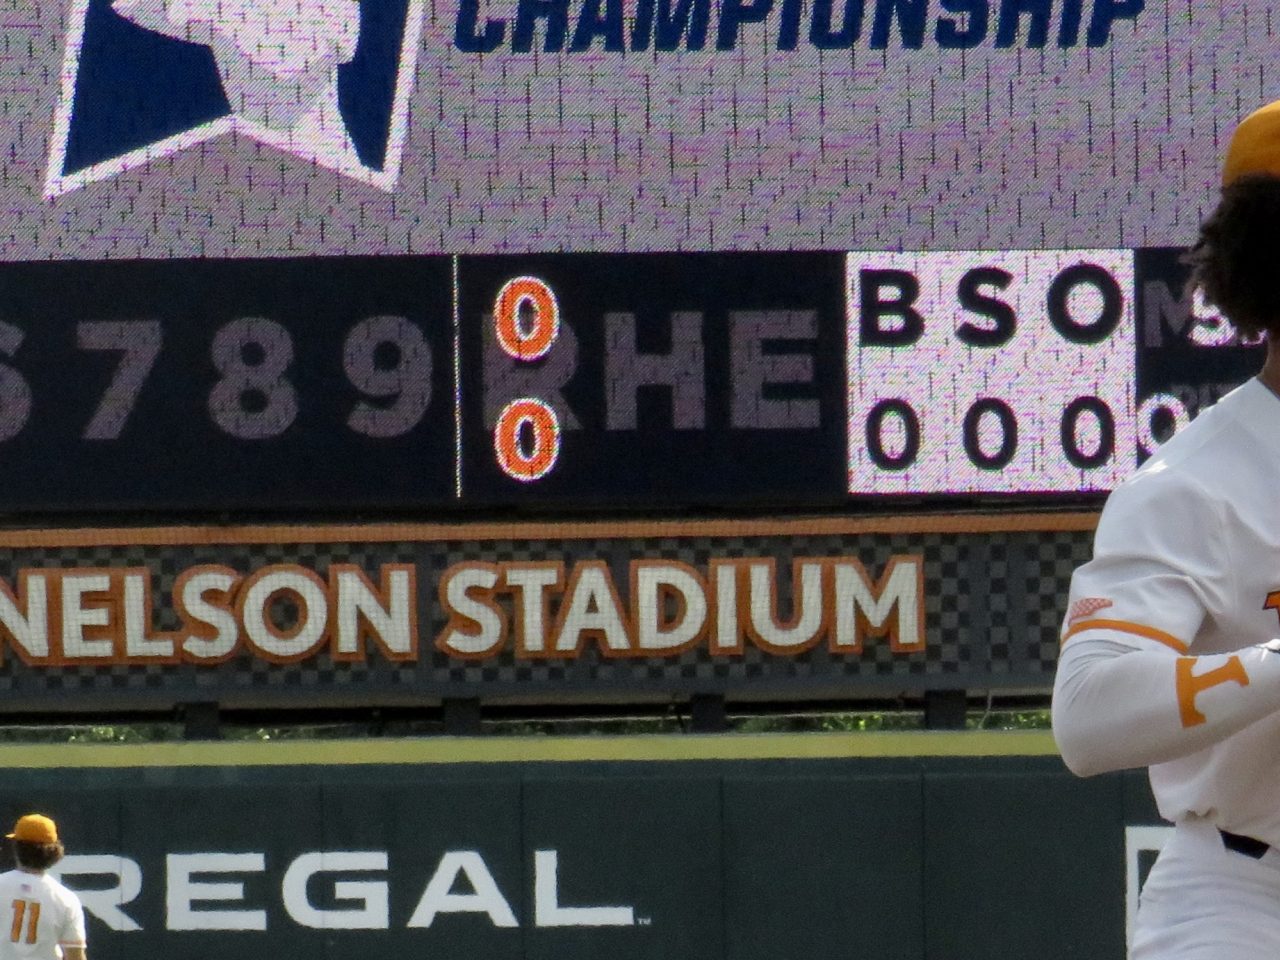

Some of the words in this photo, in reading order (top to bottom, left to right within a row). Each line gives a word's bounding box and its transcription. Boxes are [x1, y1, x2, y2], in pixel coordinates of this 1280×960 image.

[452, 0, 1146, 53] CHAMPIONSHIP
[492, 275, 560, 361] 0
[858, 268, 925, 348] B
[954, 266, 1018, 348] S
[76, 319, 163, 441] 7
[208, 316, 299, 440] 8
[342, 314, 434, 438] 9
[605, 310, 705, 431] H
[728, 308, 820, 430] E
[493, 397, 560, 482] 0
[865, 398, 920, 471] 0
[962, 396, 1018, 470] 0
[1060, 395, 1116, 469] 0
[0, 560, 417, 662] NELSON
[441, 557, 923, 659] STADIUM
[1175, 655, 1250, 728] T
[10, 898, 41, 945] 11
[46, 849, 635, 931] REGAL
